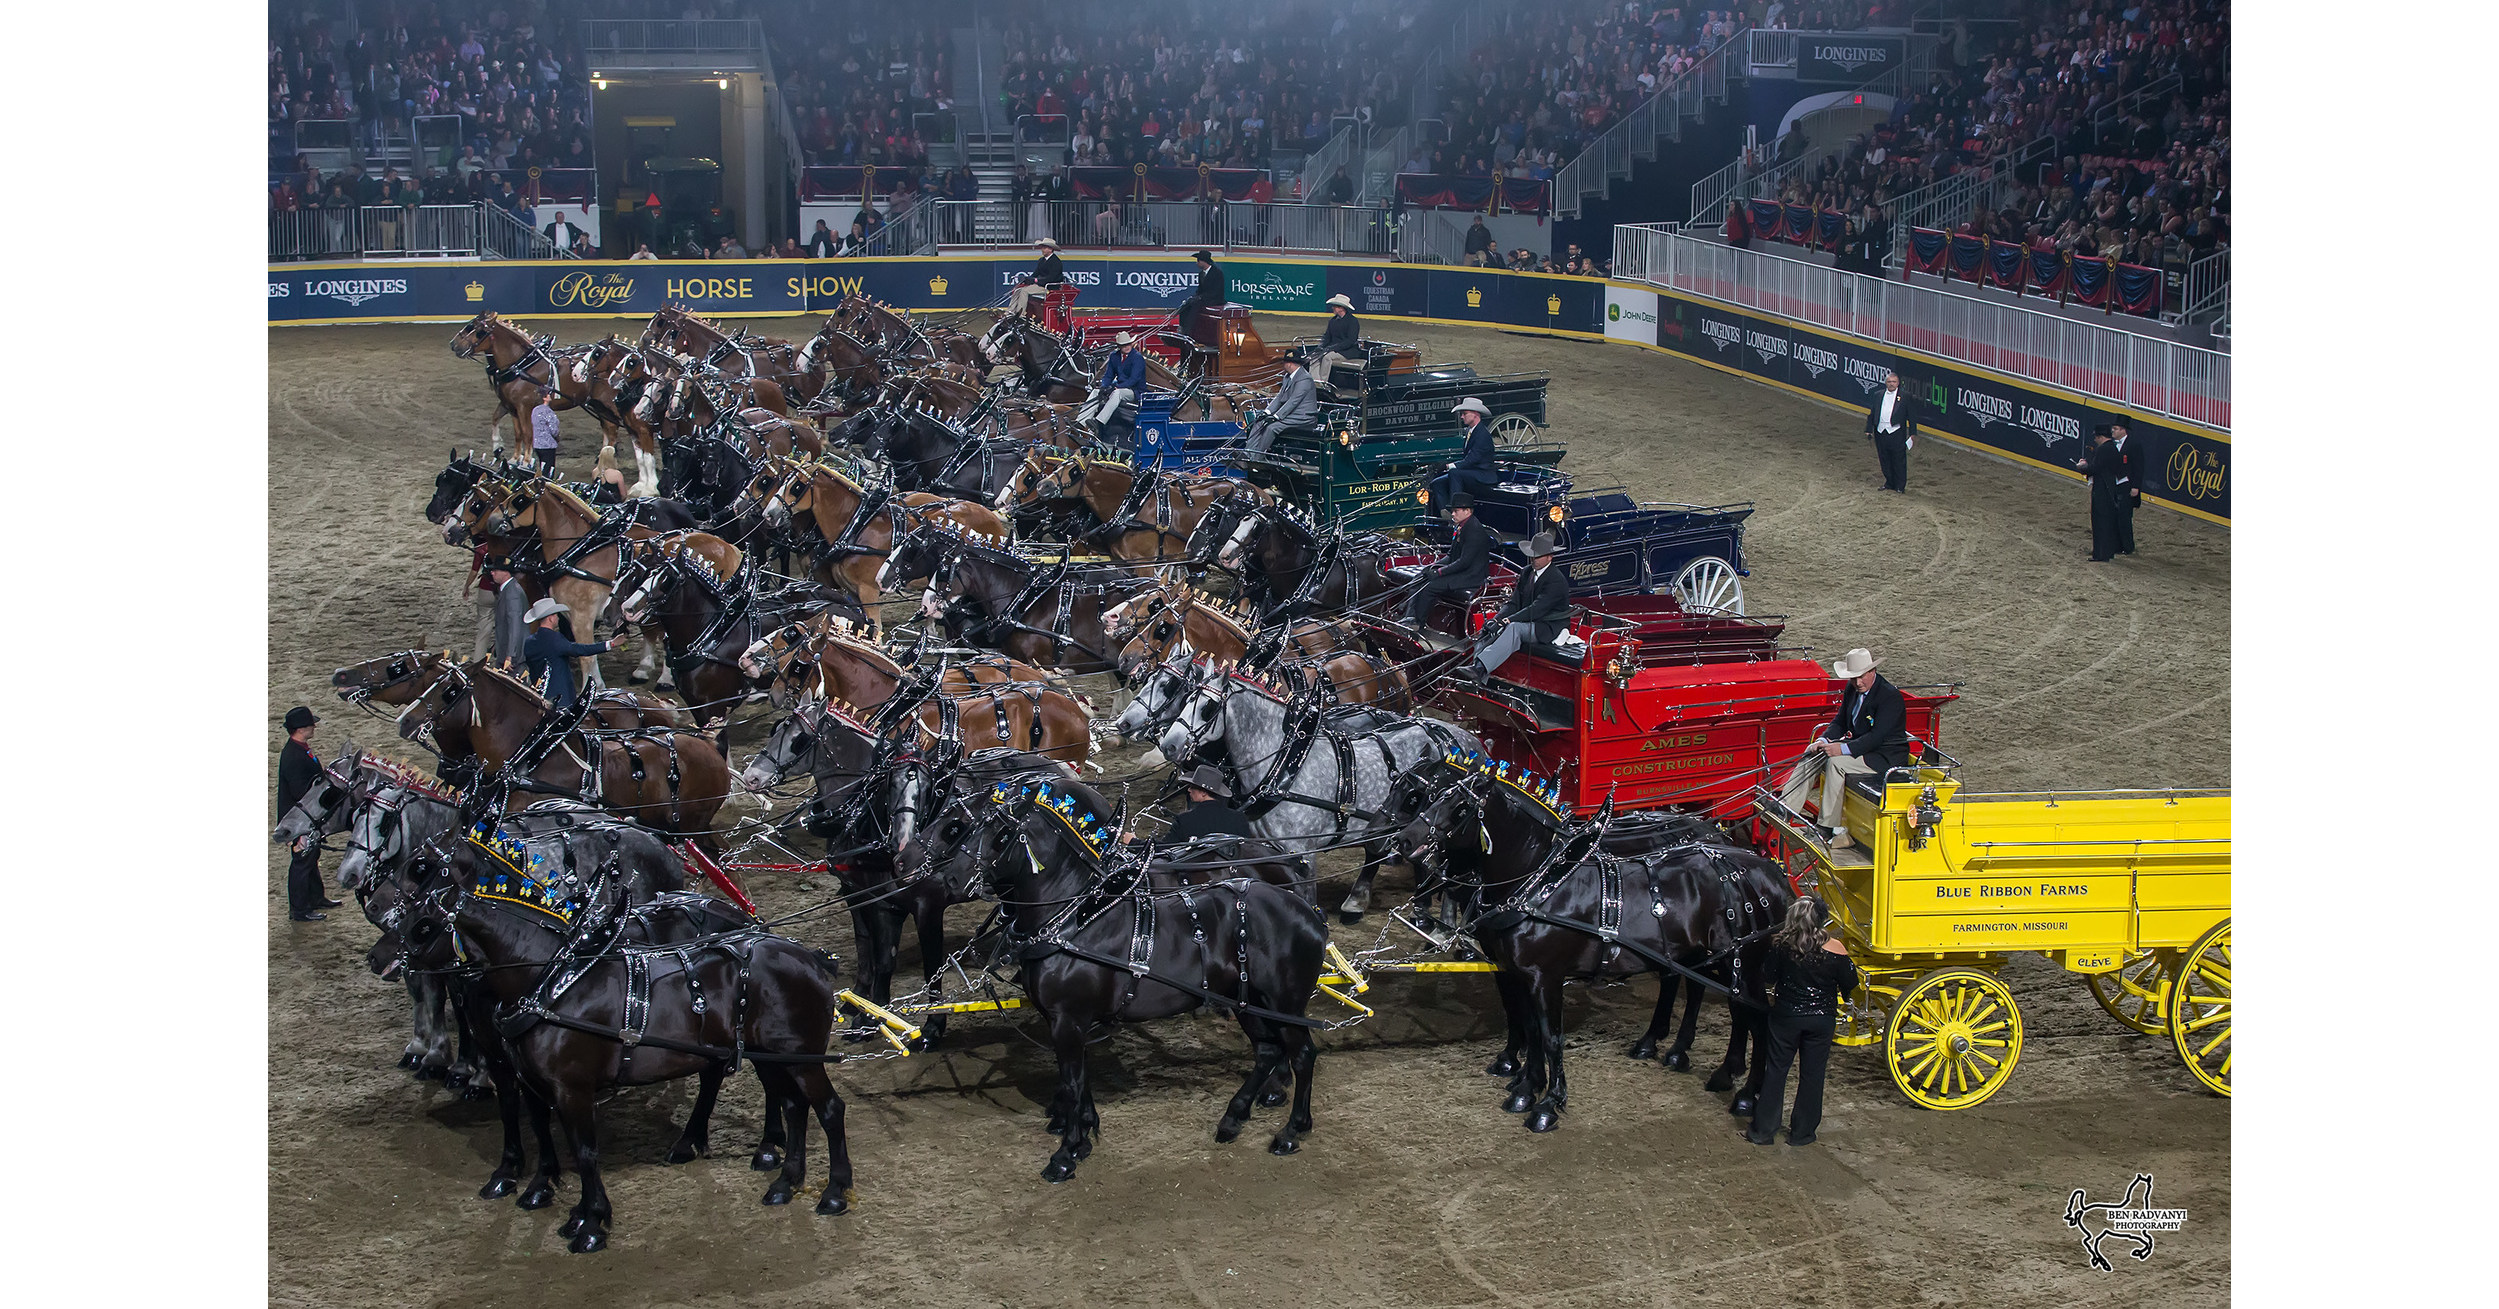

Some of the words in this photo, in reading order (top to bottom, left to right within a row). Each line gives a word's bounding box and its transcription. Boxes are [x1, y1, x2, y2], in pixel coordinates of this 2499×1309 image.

[1814, 46, 1886, 62] LONGINES
[603, 272, 625, 284] The
[1002, 271, 1101, 285] LONES
[1116, 271, 1199, 286] LONGINE
[305, 279, 408, 296] LONGINES
[549, 271, 636, 308] Royal
[667, 278, 753, 299] HORSE
[787, 276, 864, 297] SHOW
[1231, 279, 1315, 296] HORSEWARE
[1363, 286, 1395, 295] EQUESTRIAN
[1368, 294, 1390, 303] CANADA
[1622, 309, 1641, 321] JOHN
[1642, 312, 1656, 324] DEERE
[1701, 318, 1741, 344] LONGINES
[1746, 330, 1788, 356] LONGINES
[1793, 342, 1838, 371] LONGINES
[1843, 356, 1891, 383] LONGINES
[1367, 403, 1415, 417] BROCKWOOD
[1957, 387, 2013, 420] LONGINES
[1425, 413, 1436, 421] PA
[2020, 405, 2081, 440] LONGINES
[2204, 450, 2219, 467] The
[2166, 442, 2227, 501] Royal
[1349, 483, 1391, 495] LOR-ROB
[1602, 697, 1617, 724] A
[1640, 733, 1708, 752] AMES
[1612, 753, 1735, 777] CONSTRUCTION
[1936, 886, 1972, 898] BLUE
[1980, 885, 2033, 898] RIBBON
[2040, 884, 2088, 896] FARMS
[2023, 921, 2068, 931] MISSOURI
[2077, 957, 2112, 968] CLEVE
